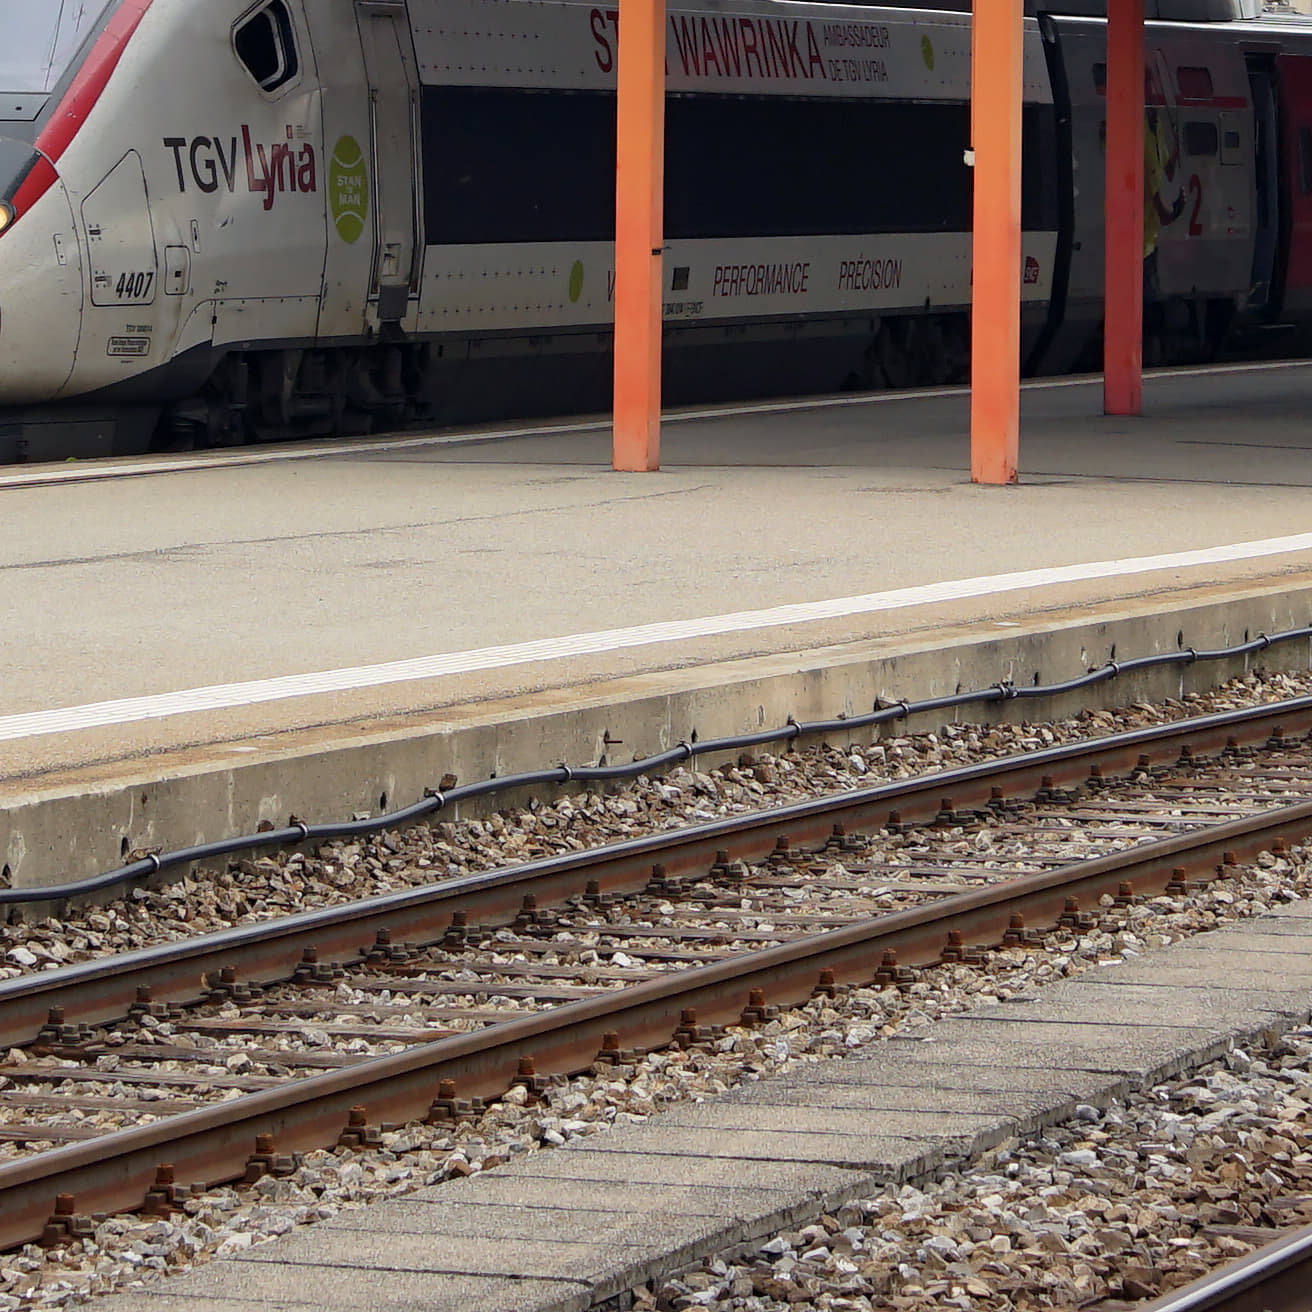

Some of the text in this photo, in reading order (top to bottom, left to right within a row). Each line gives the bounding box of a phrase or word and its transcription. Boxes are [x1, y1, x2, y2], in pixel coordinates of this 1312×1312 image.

[670, 15, 828, 80] WAWRINKA
[823, 23, 891, 48] AMBASSADEUR
[828, 59, 842, 82] DE
[842, 59, 861, 82] TGV
[163, 124, 316, 211] TGV Lyria
[1188, 173, 1204, 237] 2
[116, 272, 154, 299] 4407
[713, 253, 904, 297] PERFORMANCE PRÉCISION
